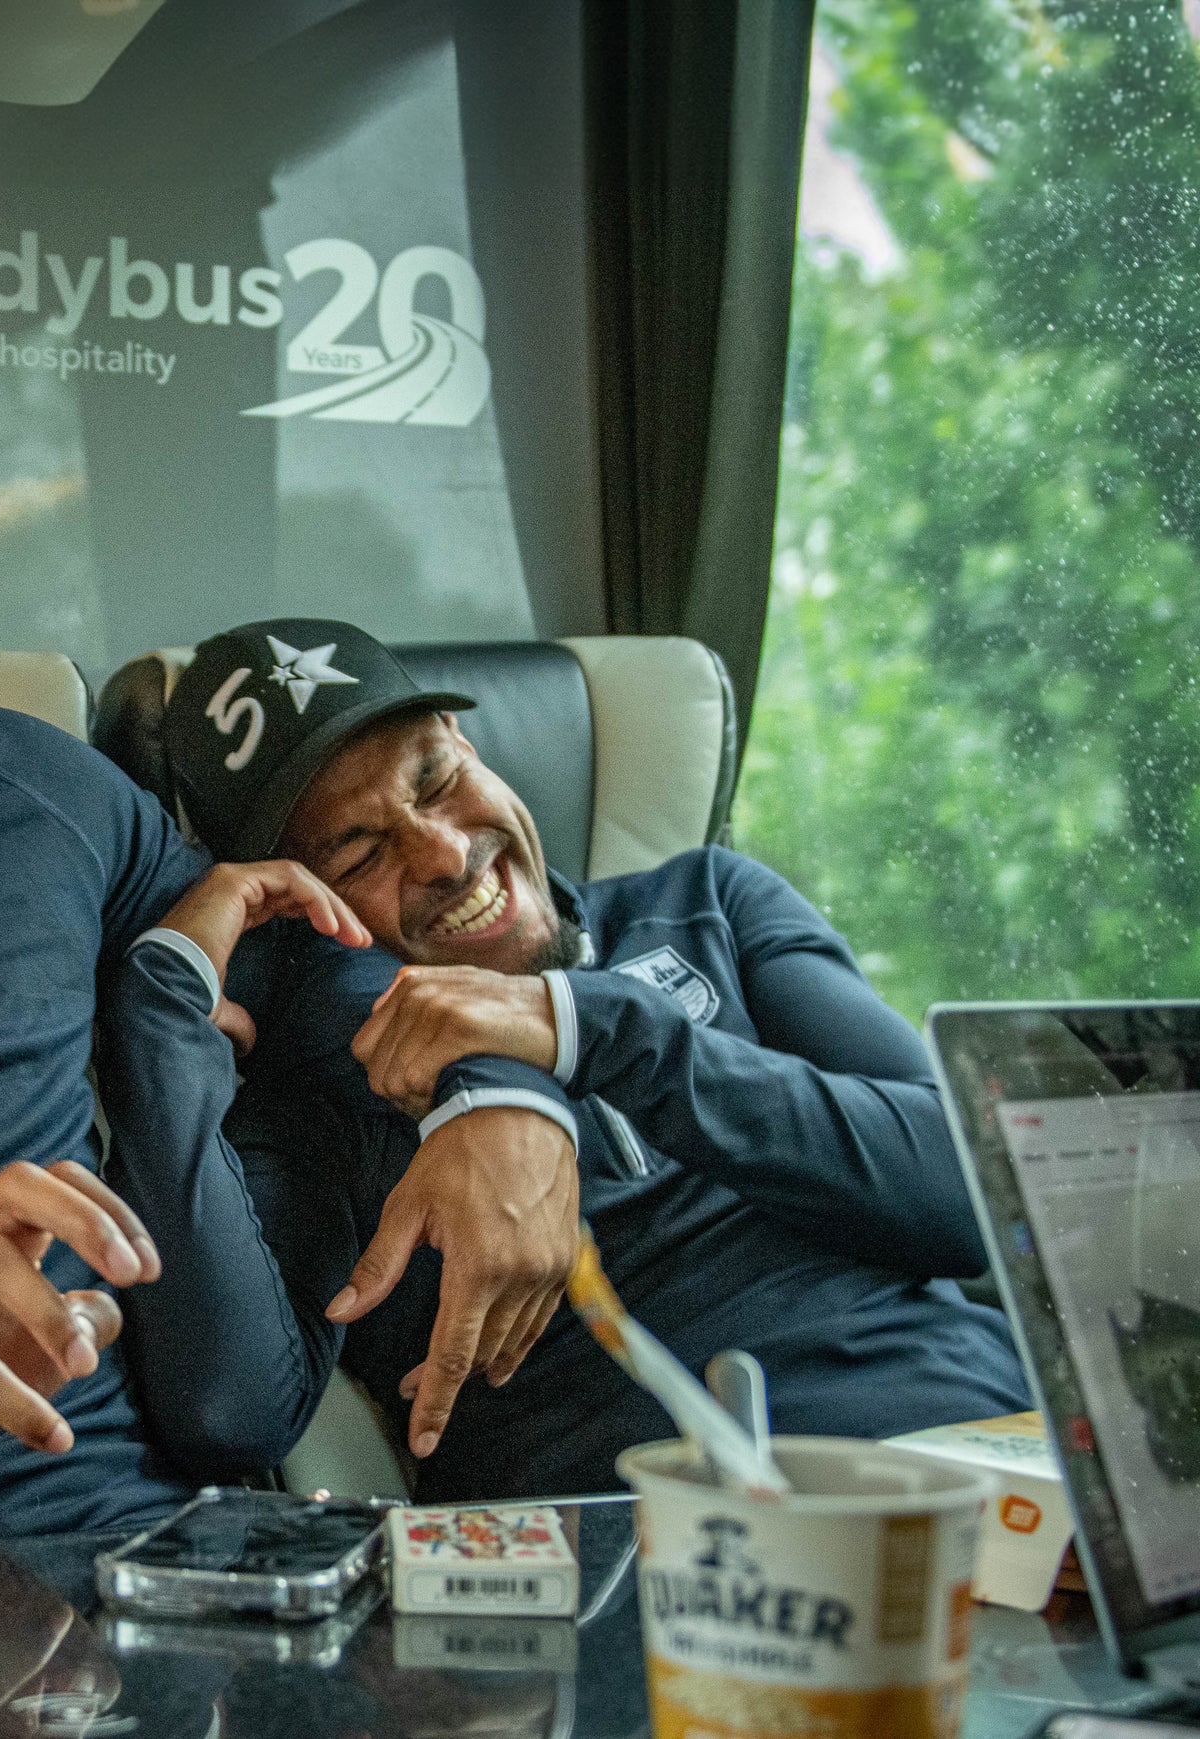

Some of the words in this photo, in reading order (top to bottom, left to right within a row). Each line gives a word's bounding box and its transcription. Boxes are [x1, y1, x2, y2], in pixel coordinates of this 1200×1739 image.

[284, 238, 489, 405] 20
[0, 332, 177, 386] hospitality
[304, 347, 363, 369] Years
